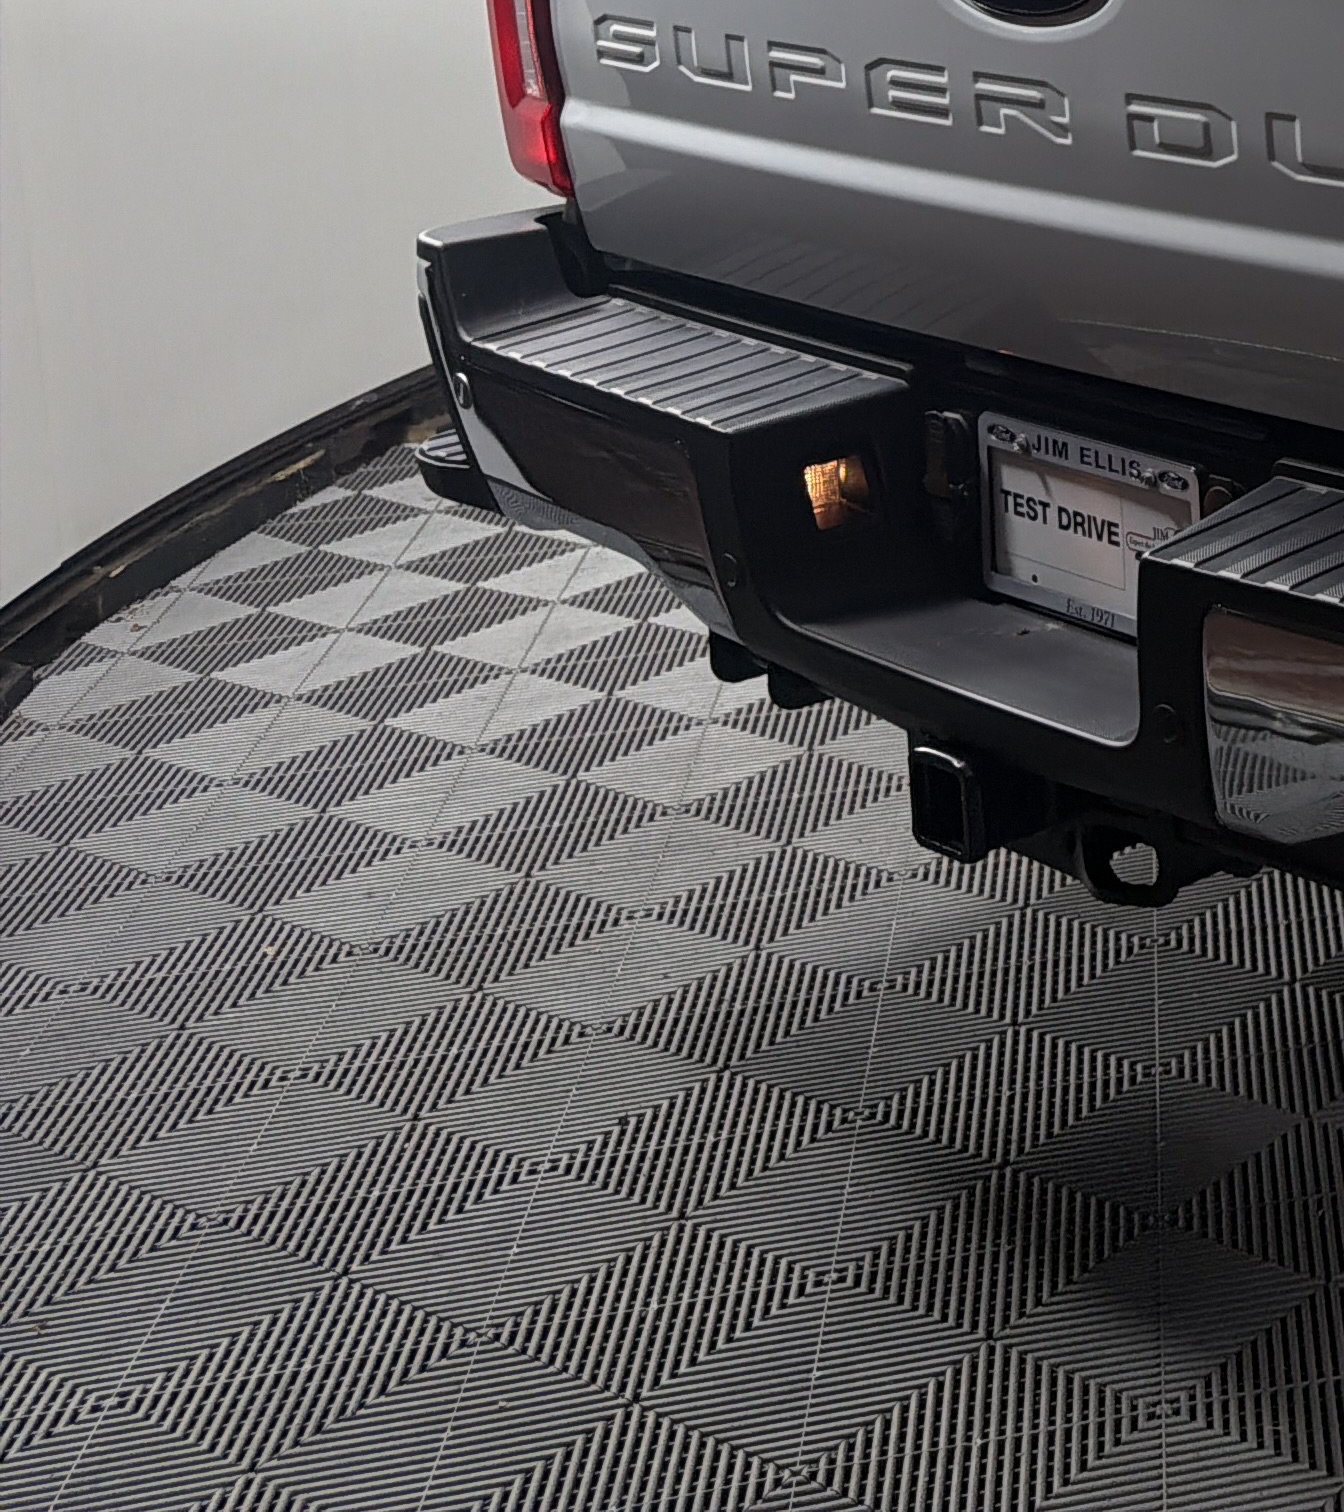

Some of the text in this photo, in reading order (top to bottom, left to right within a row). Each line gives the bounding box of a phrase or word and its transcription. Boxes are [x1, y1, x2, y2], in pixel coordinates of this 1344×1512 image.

[593, 13, 1074, 145] SUPER
[1032, 434, 1142, 481] JIM ELLIS
[1001, 489, 1121, 548] TEST DRIVE
[1091, 606, 1116, 628] 1971
